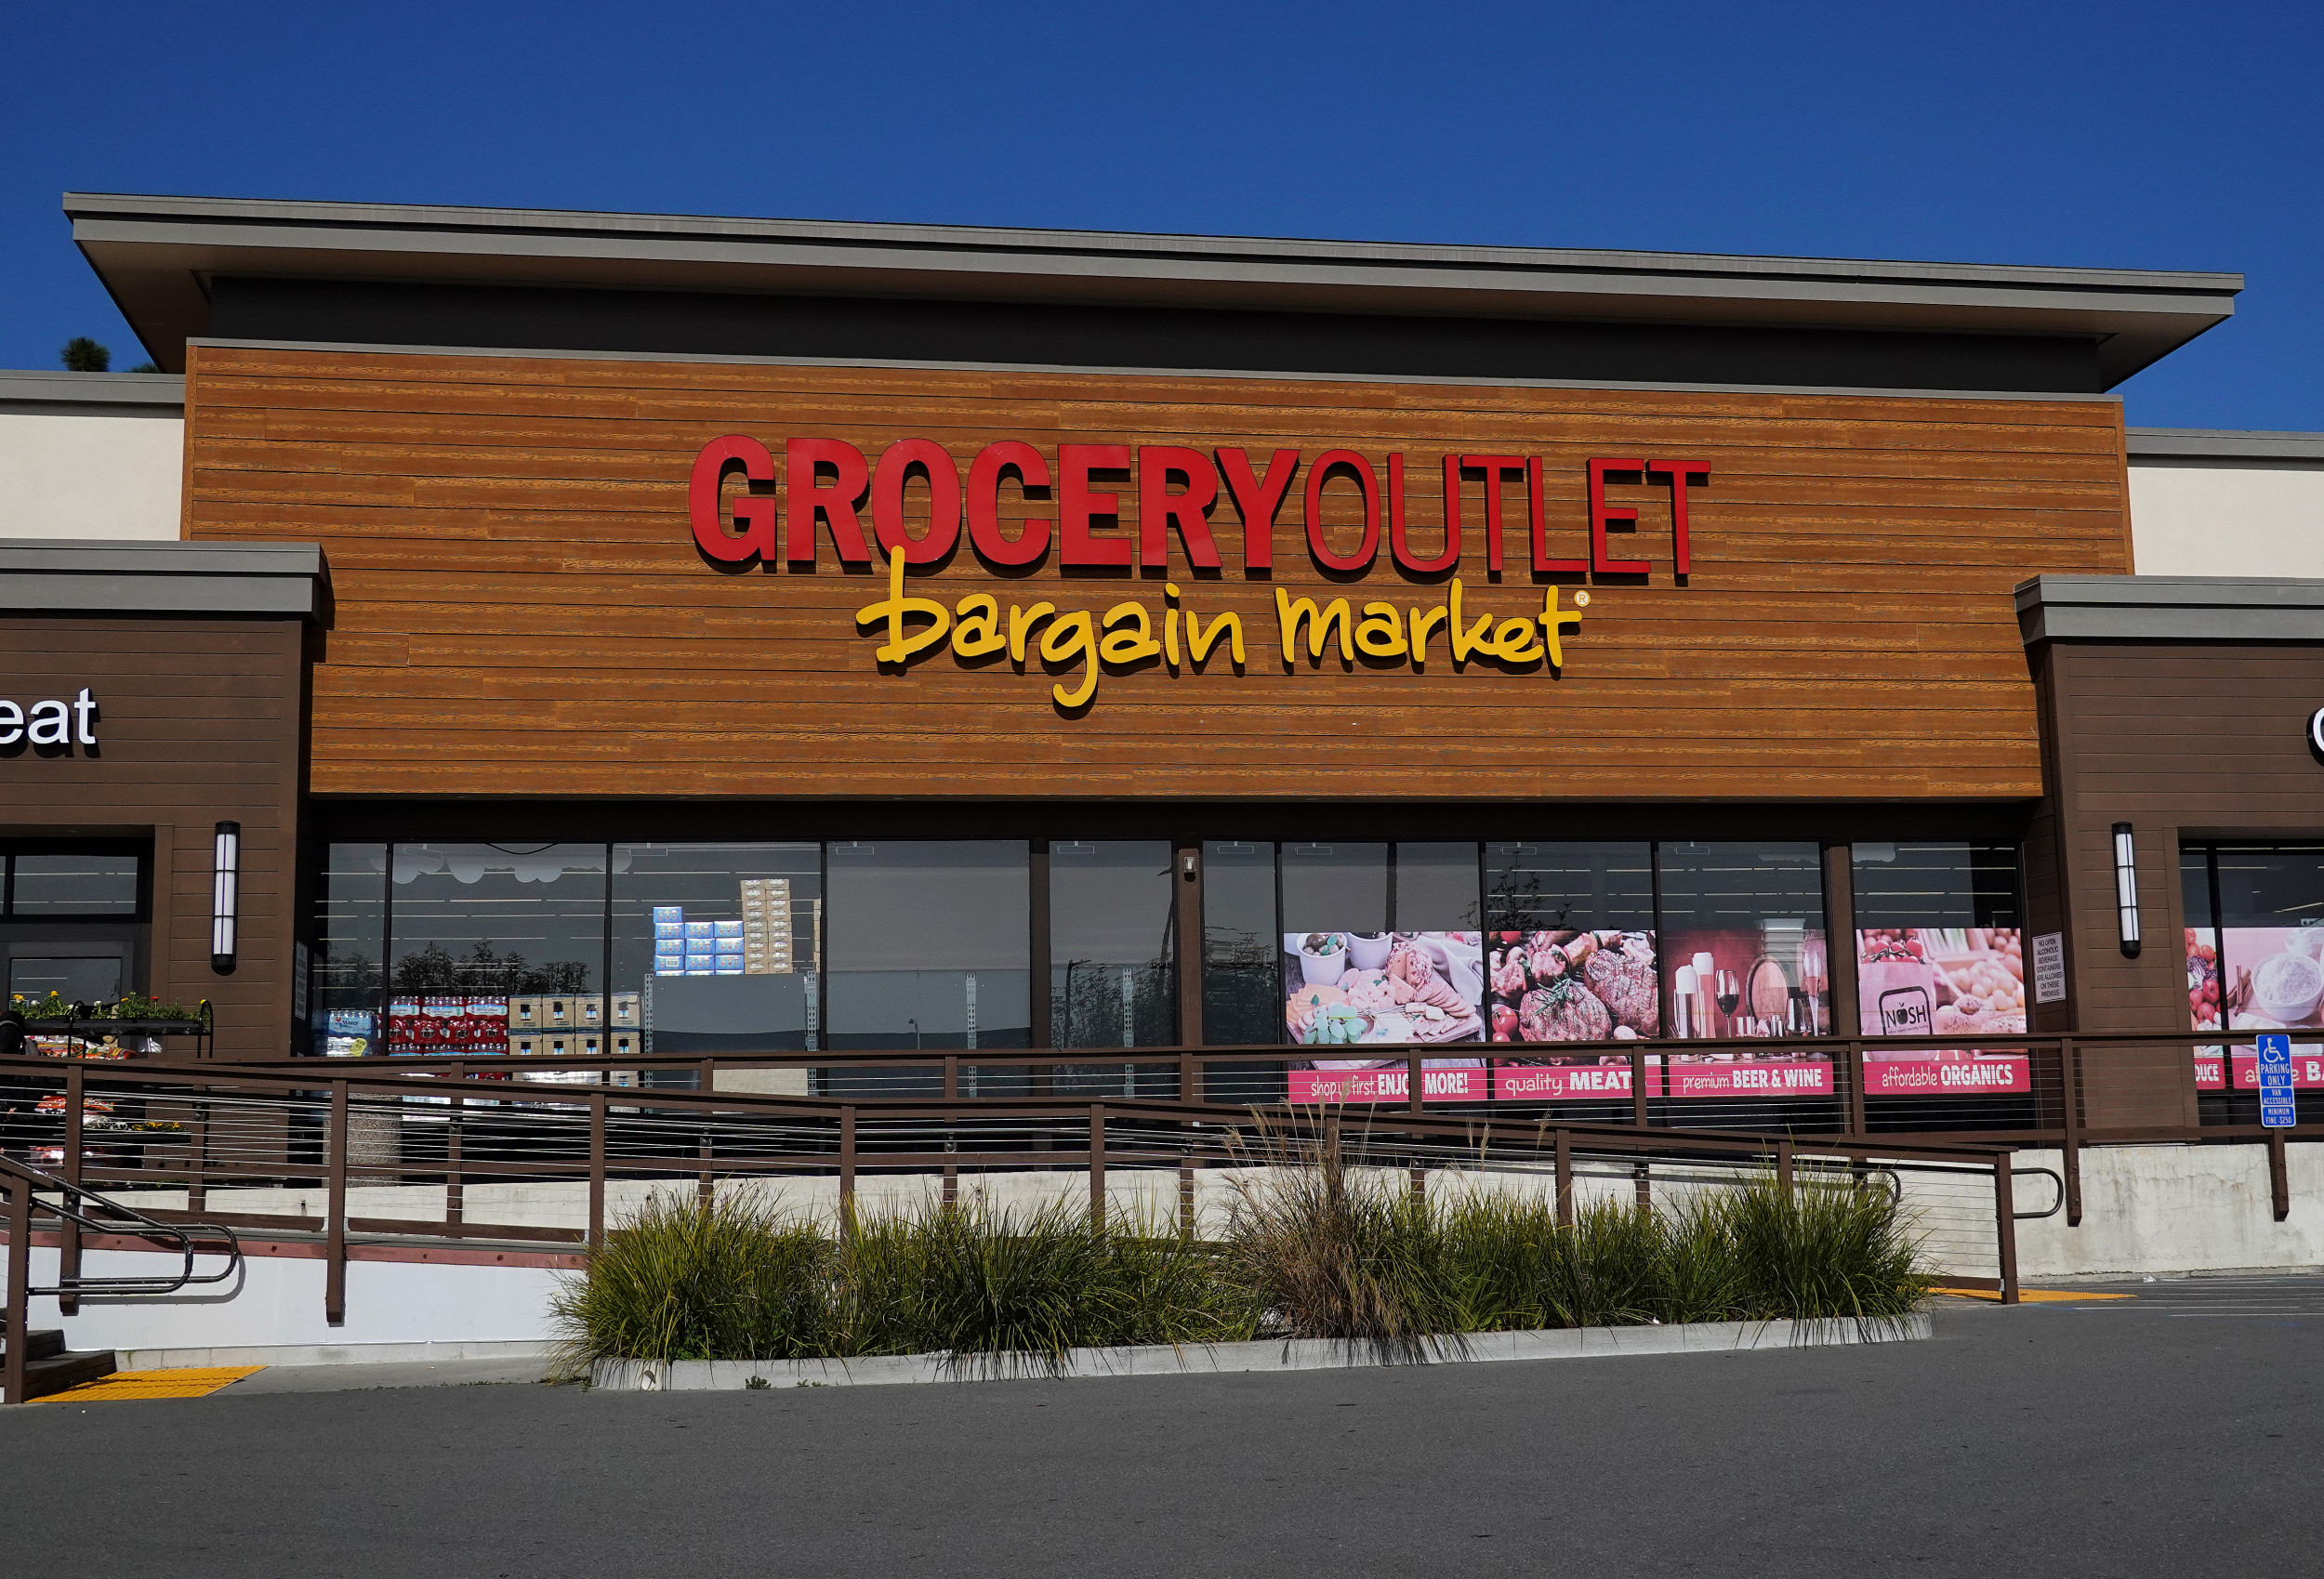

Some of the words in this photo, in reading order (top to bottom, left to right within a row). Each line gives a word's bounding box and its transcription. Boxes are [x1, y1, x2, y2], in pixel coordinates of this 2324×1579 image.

[855, 545, 1246, 707] bargain
[1275, 577, 1582, 668] market
[1882, 1066, 1938, 1087] affordable
[1940, 1064, 2014, 1086] ORGANICS
[2260, 1063, 2290, 1074] PARKING
[1311, 1075, 1337, 1101] shop
[1378, 1072, 1409, 1096] ENJO
[1424, 1072, 1469, 1095] MORE!
[1505, 1072, 1564, 1097] quality
[1569, 1071, 1632, 1090] MEAT
[1683, 1072, 1730, 1095] premium
[1732, 1070, 1768, 1088] BEER
[1771, 1069, 1781, 1087] &
[1783, 1068, 1823, 1087] WINE
[2267, 1074, 2286, 1086] ONLY
[2263, 1097, 2291, 1105] ACCESSIBLE
[2271, 1088, 2282, 1097] VAN
[2265, 1116, 2277, 1125] FINE
[2278, 1116, 2292, 1125] $250
